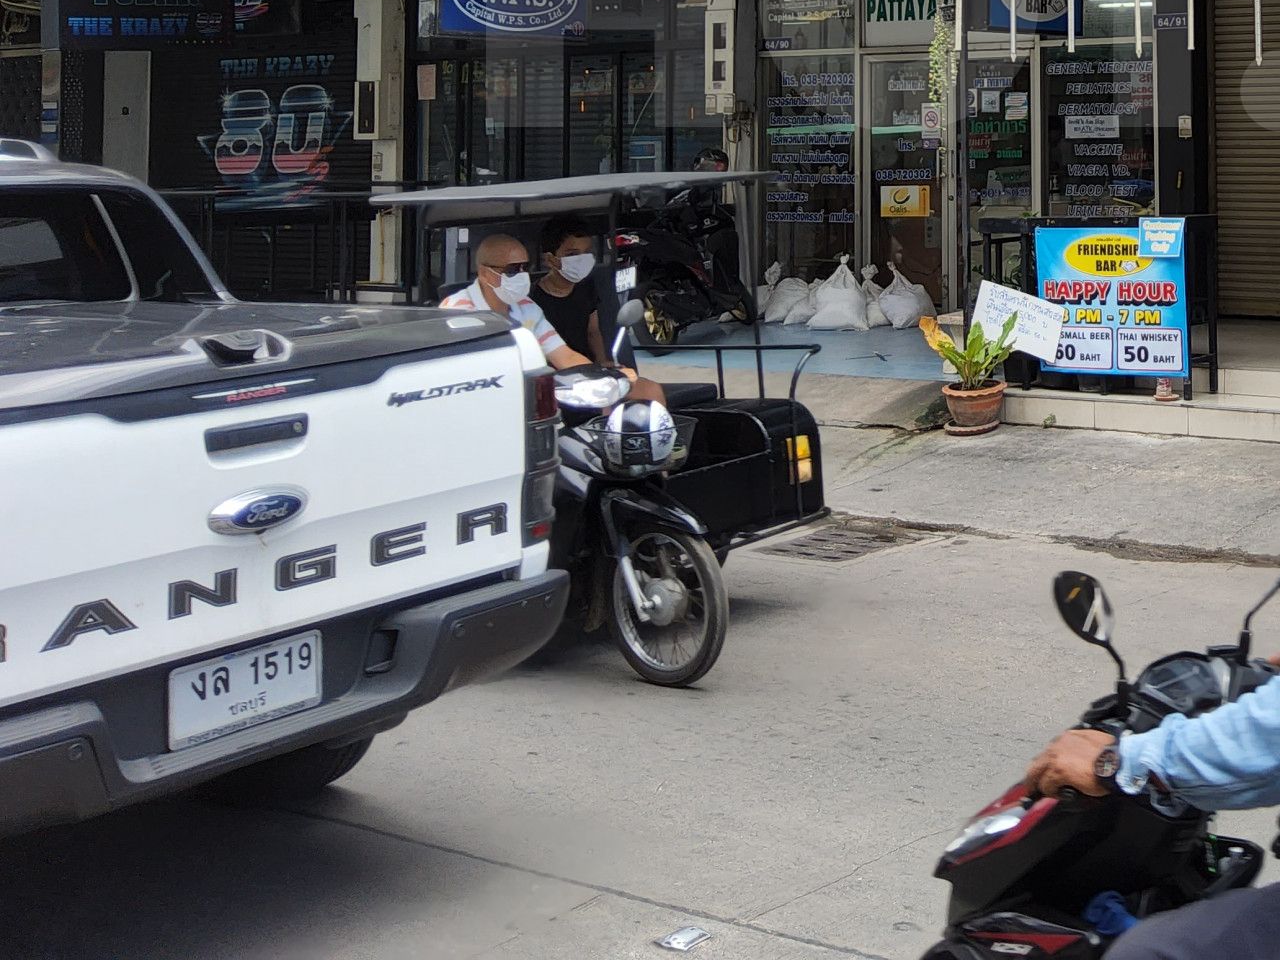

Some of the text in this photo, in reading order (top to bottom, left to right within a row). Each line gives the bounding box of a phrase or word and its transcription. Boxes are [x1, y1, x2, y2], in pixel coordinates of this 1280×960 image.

[465, 1, 495, 22] Capital
[68, 17, 189, 37] THE KRAZY
[1157, 16, 1187, 27] 64/91
[220, 54, 335, 79] THE KRAZY
[1046, 61, 1153, 74] GENERAL MEDICINE
[781, 71, 855, 87] โทร. 038-720302
[1066, 82, 1132, 94] PEDIATRICS
[1058, 102, 1140, 115] DERMATOLOGY
[898, 138, 917, 151] โทร.
[875, 169, 932, 180] 038-720302
[1068, 164, 1108, 176] VIAGRA
[1066, 184, 1138, 196] BLOOD TEST
[1067, 205, 1135, 217] URINE TEST
[1096, 261, 1117, 272] BAR
[1044, 281, 1178, 304] HAPPY HOUR
[1076, 309, 1102, 325] PM
[1119, 310, 1129, 324] 7
[1135, 311, 1161, 325] PM
[1060, 331, 1111, 340] SMALL BEER
[1119, 332, 1178, 342] THAI WHISKEY
[1080, 354, 1101, 362] BAHT
[1124, 346, 1175, 364] 50 BAHT
[226, 386, 287, 403] RANGER
[387, 375, 506, 407] WILDTRAK
[246, 499, 289, 524] Ford
[0, 502, 508, 663] ANGER
[191, 642, 312, 702] งล 1519
[228, 691, 267, 716] ชลบุรี
